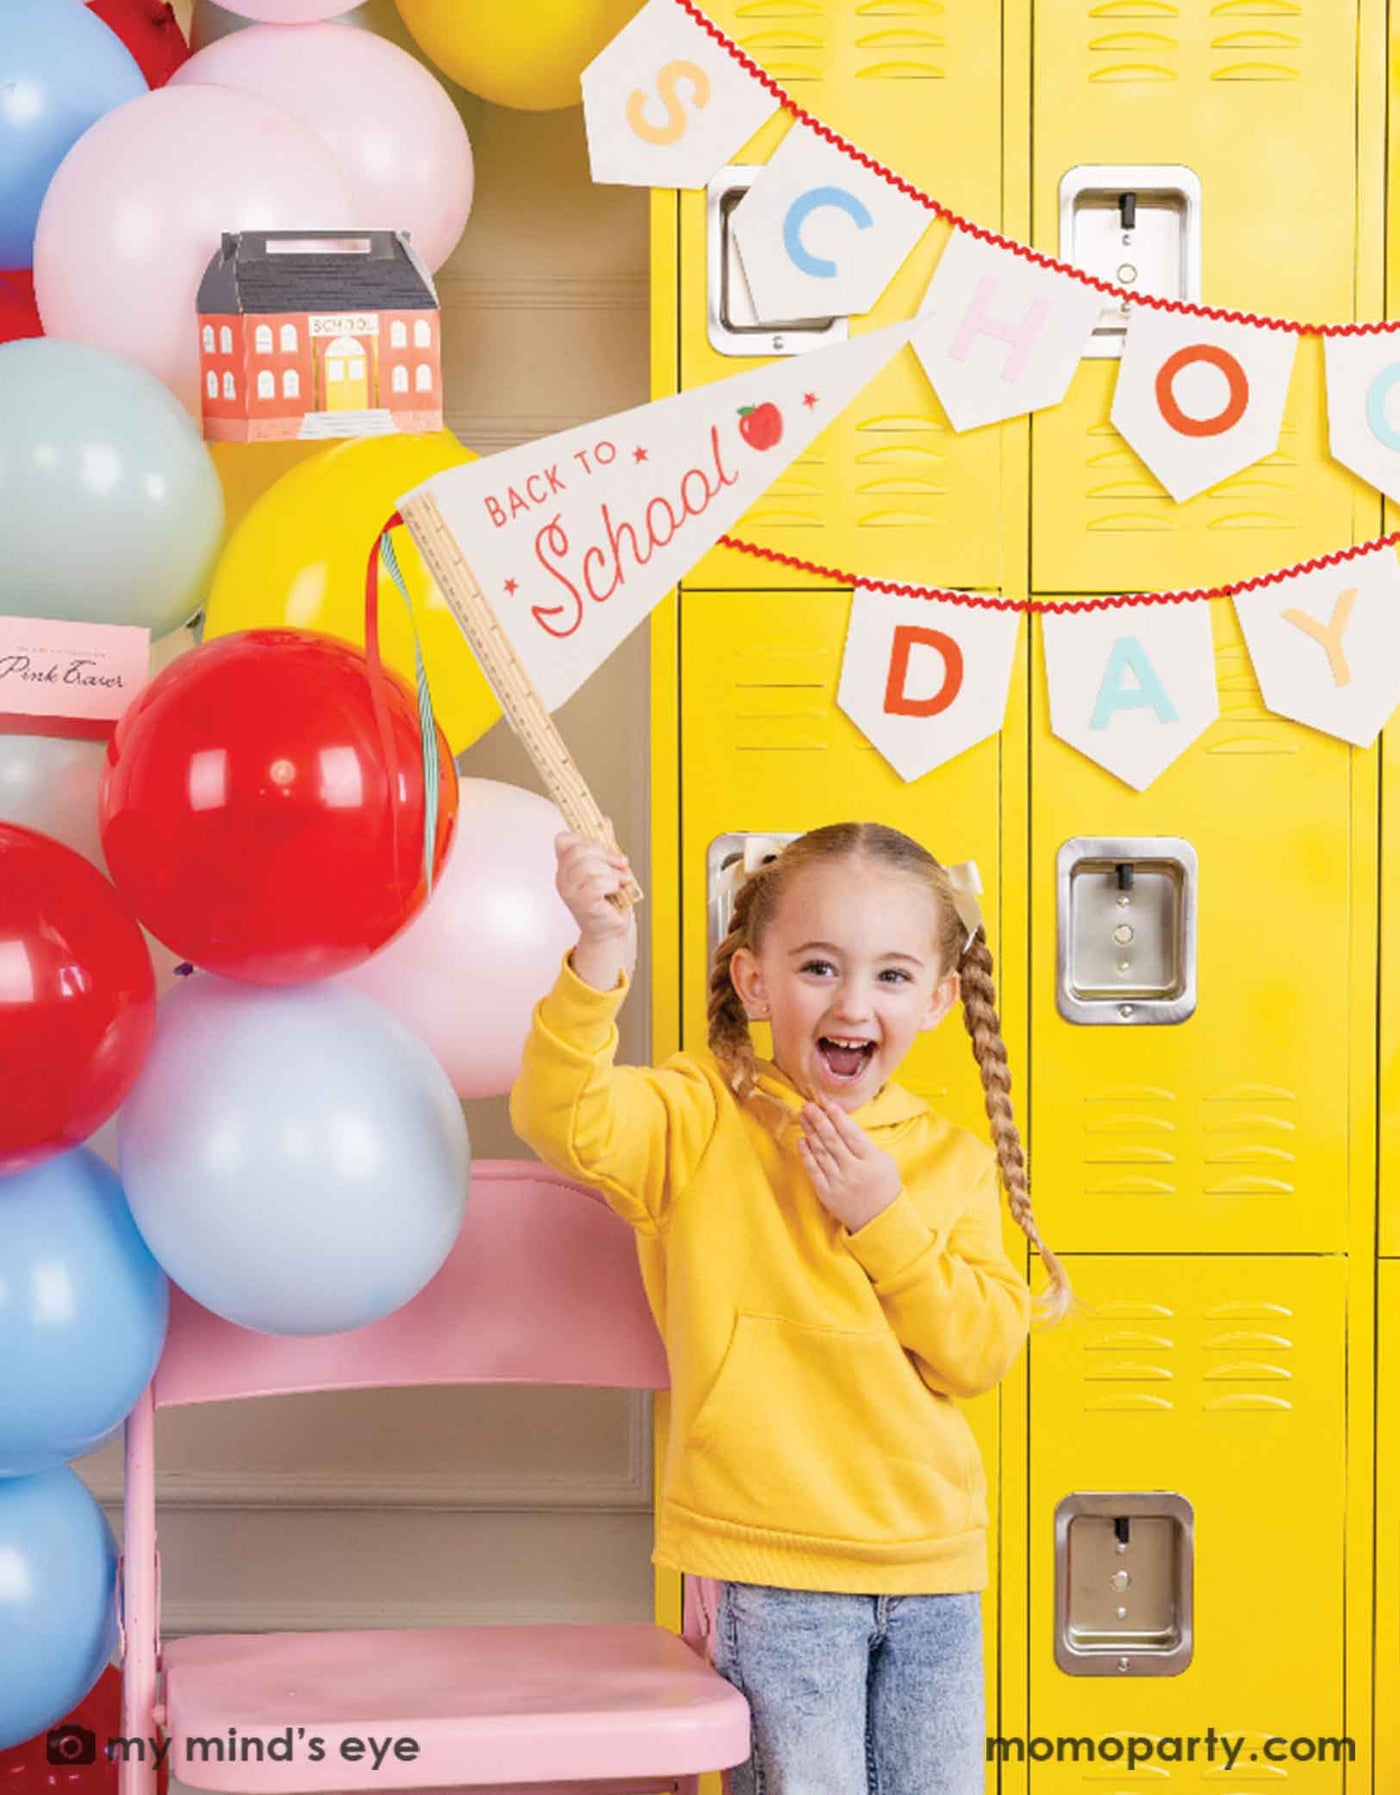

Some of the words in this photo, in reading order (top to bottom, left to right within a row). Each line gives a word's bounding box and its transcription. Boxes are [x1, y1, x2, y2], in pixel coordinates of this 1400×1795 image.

[484, 465, 566, 528] BACK
[574, 441, 616, 475] TO
[531, 425, 739, 638] School
[0, 655, 59, 683] Pink
[62, 659, 124, 688] Eraser
[883, 587, 1358, 730] DAY
